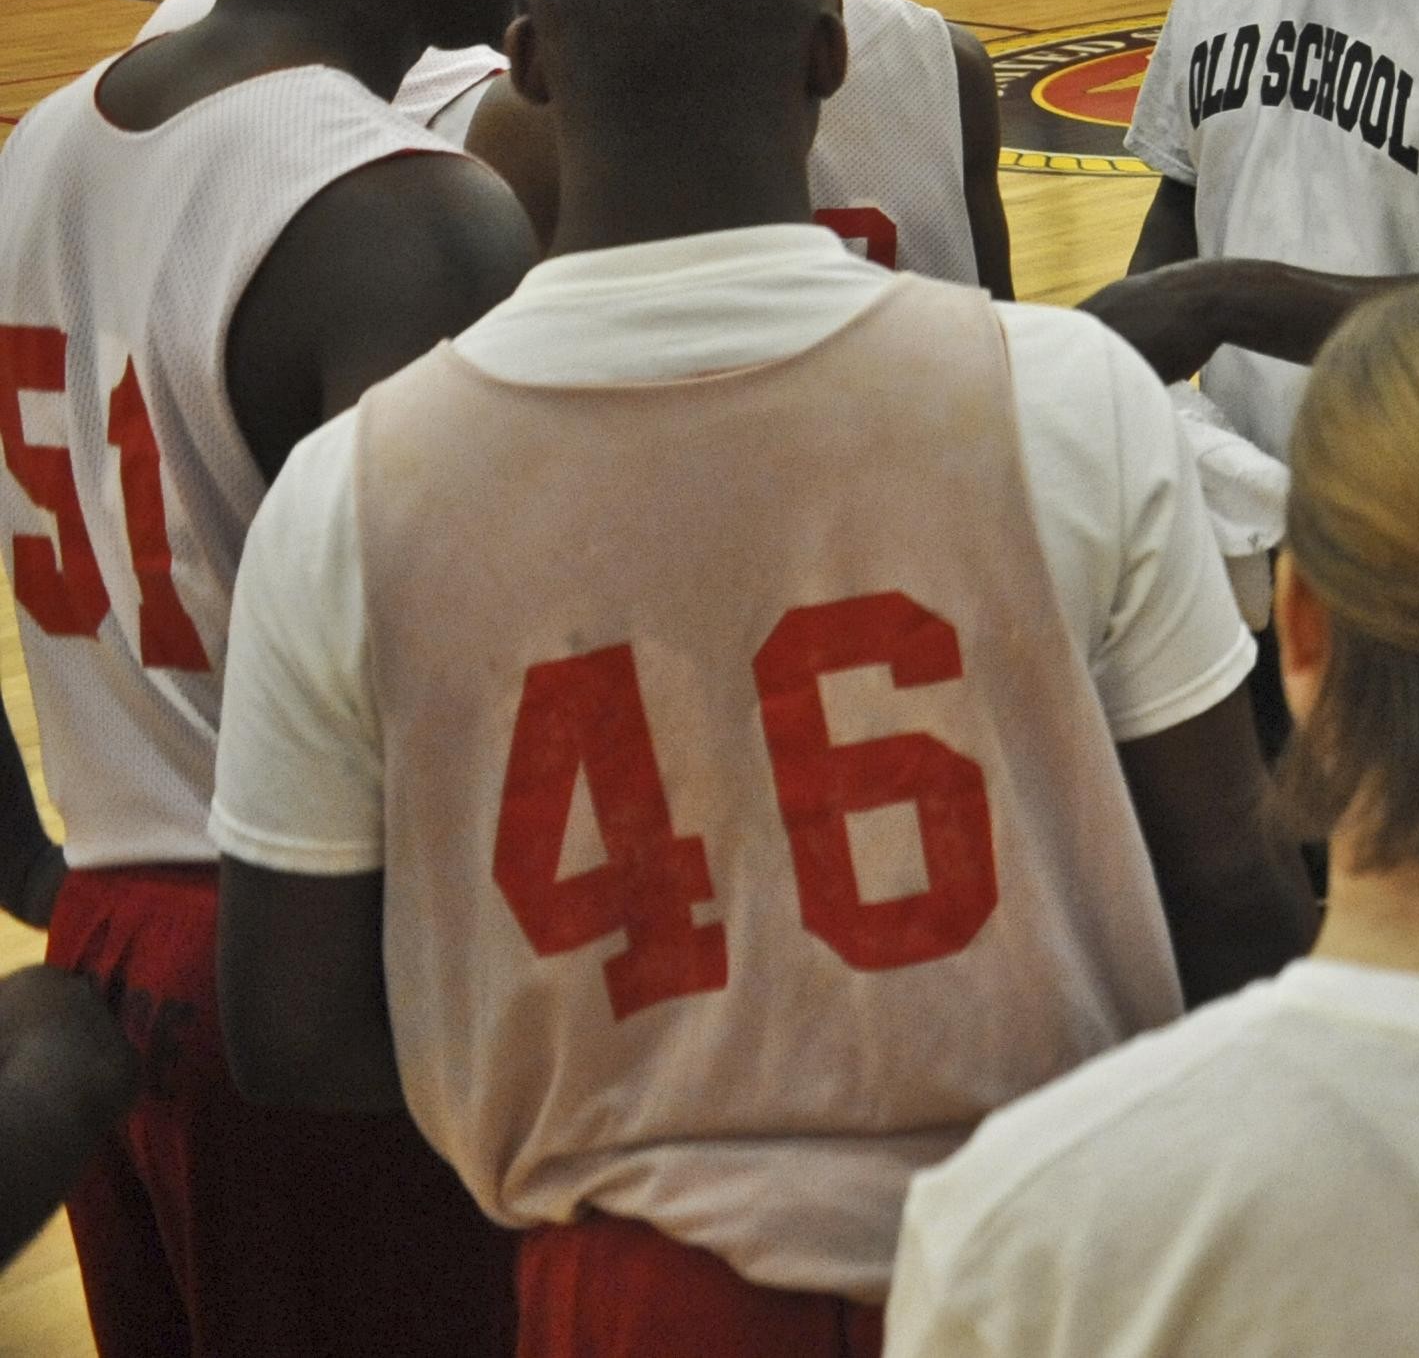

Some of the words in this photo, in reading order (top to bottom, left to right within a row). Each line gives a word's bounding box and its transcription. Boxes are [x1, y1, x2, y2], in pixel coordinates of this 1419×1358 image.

[1188, 23, 1262, 128] OLD
[1259, 20, 1419, 176] SCHOOL
[0, 324, 211, 674] 51
[491, 589, 998, 1022] 46
